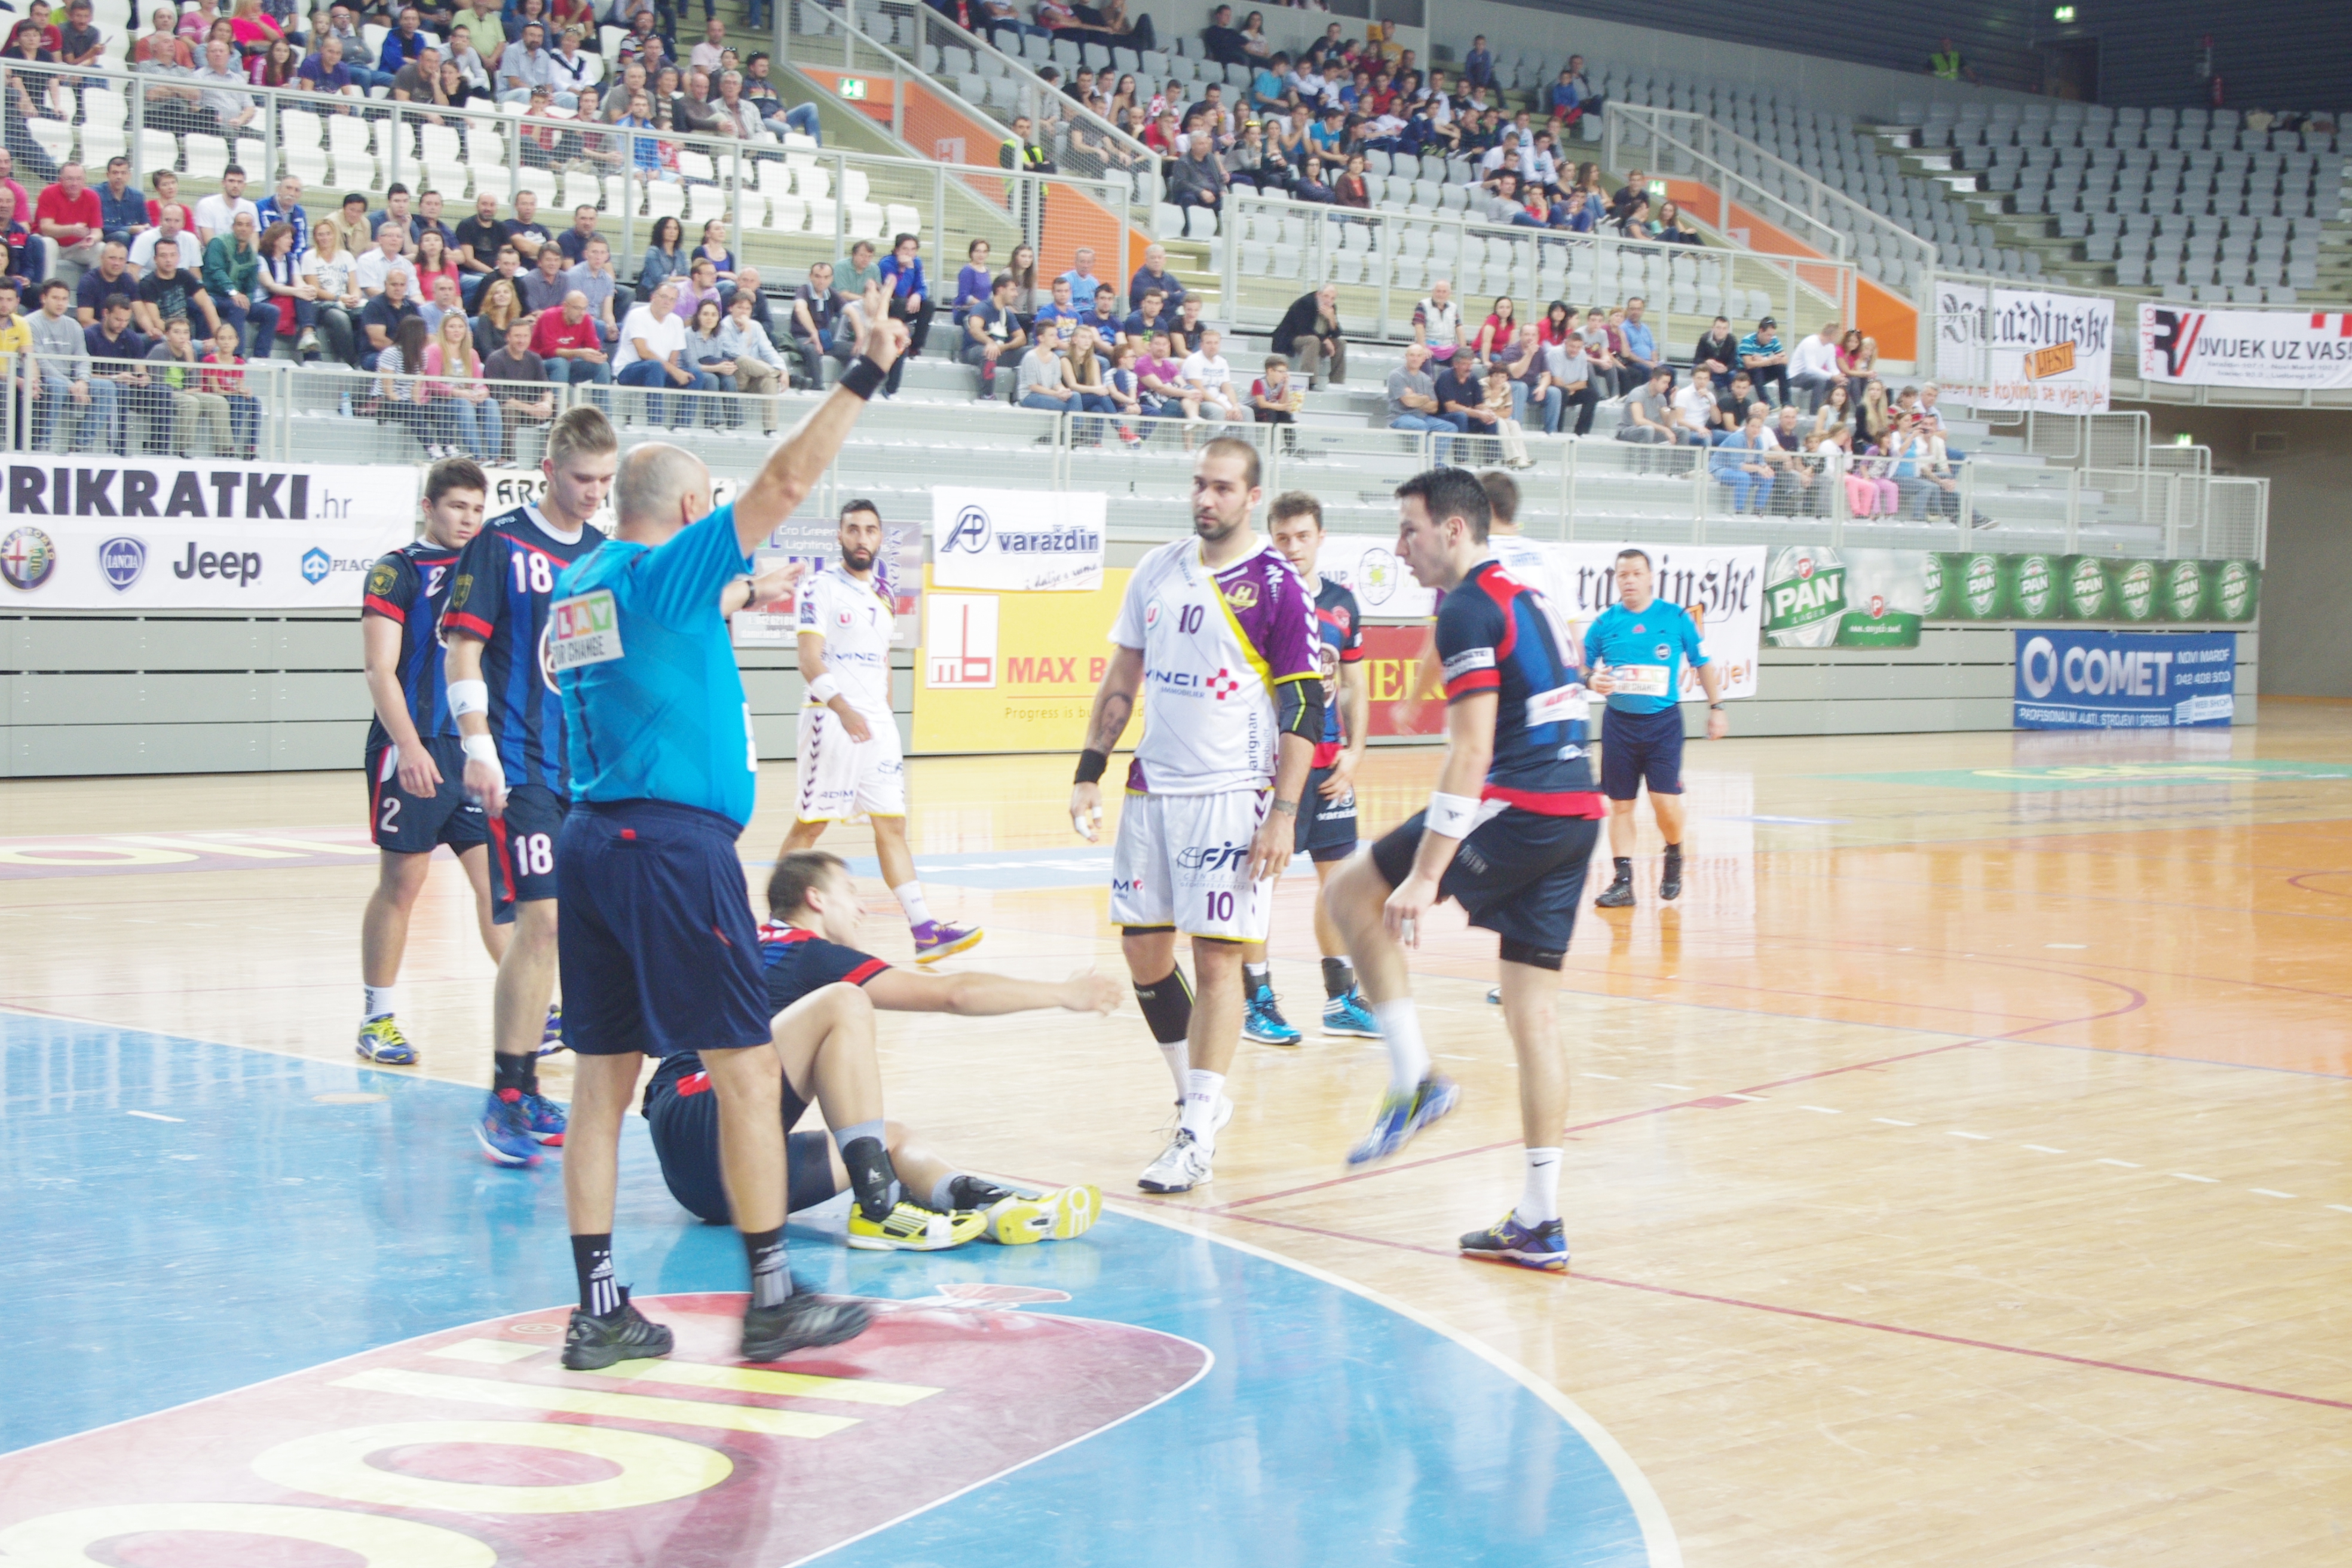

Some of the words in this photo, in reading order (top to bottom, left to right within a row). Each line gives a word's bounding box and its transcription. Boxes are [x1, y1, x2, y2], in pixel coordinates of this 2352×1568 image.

[2141, 308, 2155, 373] radio
[2272, 340, 2301, 359] UZ
[0, 464, 352, 520] RIKRATKI.hr
[779, 525, 799, 536] Cro
[996, 525, 1100, 555] varaždin
[785, 540, 833, 552] Lighting
[107, 555, 139, 569] LANCIA
[173, 541, 262, 587] Jeep
[330, 559, 375, 572] PIAG
[512, 551, 554, 594] 18
[425, 565, 447, 598] 2
[1925, 572, 1941, 593] AN
[1970, 574, 1995, 596] PAN
[2022, 574, 2049, 595] PAN
[2075, 576, 2103, 595] PAN
[2125, 579, 2151, 596] PAN
[2176, 577, 2199, 596] PAN
[2224, 580, 2247, 596] PAN
[1774, 573, 1839, 618] PAN
[868, 607, 877, 626] 7
[1178, 604, 1205, 635] 10
[1791, 608, 1826, 624] LAGER
[2177, 651, 2199, 664] NOVI
[2200, 648, 2230, 663] MAROF
[1007, 657, 1077, 683] MAX
[2064, 646, 2173, 696] COMET
[1160, 685, 1206, 699] IMMOBILIER
[1006, 707, 1059, 721] Progress
[1064, 706, 1073, 718] is
[1245, 712, 1260, 771] arignan
[380, 797, 402, 833] 2
[515, 832, 554, 877] 18
[1206, 890, 1235, 922] 10
